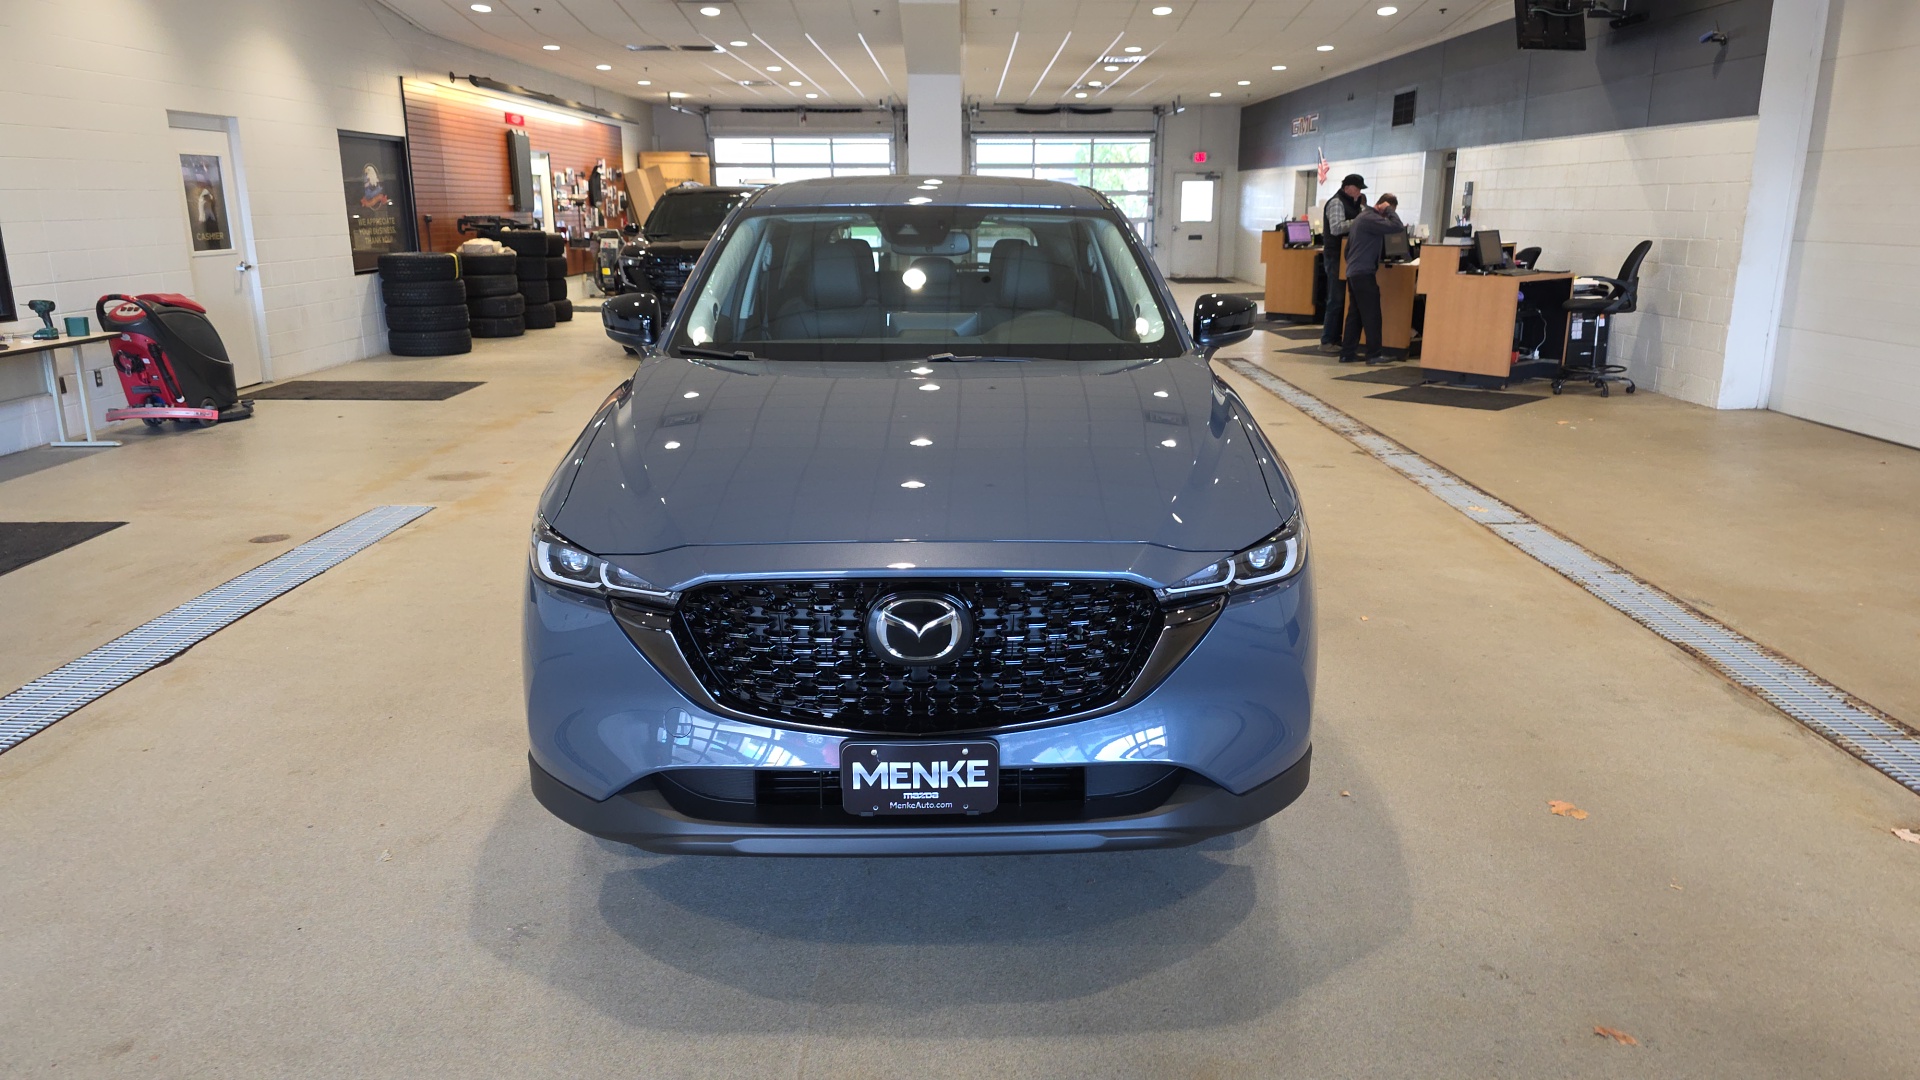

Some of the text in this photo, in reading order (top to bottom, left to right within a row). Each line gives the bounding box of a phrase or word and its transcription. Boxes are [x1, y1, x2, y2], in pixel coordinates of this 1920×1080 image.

[1292, 113, 1319, 137] GMC
[197, 232, 224, 241] CASHIER
[852, 761, 989, 790] MENKE
[889, 801, 953, 810] MenkeAuto.com
